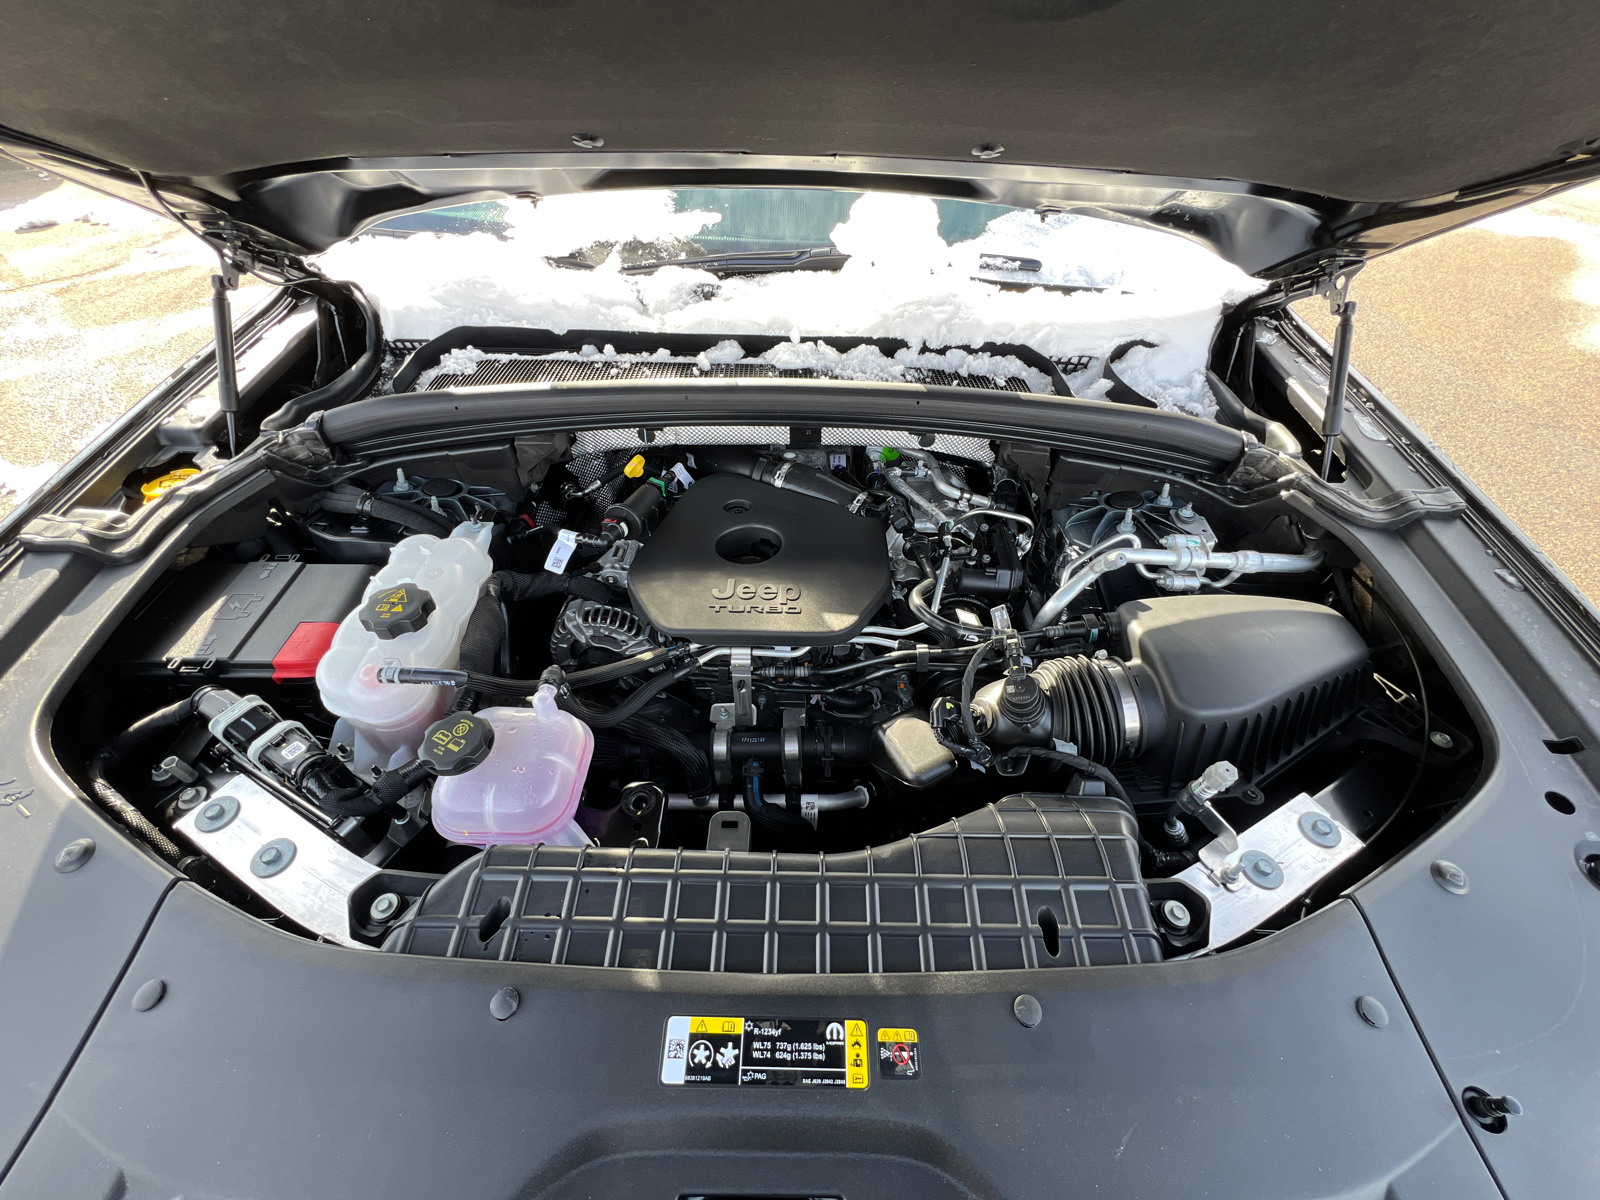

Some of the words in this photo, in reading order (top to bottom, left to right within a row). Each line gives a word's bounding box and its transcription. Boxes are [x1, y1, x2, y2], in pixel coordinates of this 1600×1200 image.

[711, 578, 802, 606] Jeep
[708, 604, 802, 614] TURBO
[753, 1027, 782, 1037] R-1234yf
[752, 1041, 772, 1049] WL75
[775, 1042, 792, 1051] 737g
[792, 1042, 812, 1051] (1.625
[812, 1043, 826, 1051] lbs)
[752, 1050, 771, 1058] WL74
[775, 1052, 791, 1060] 624g
[792, 1052, 812, 1061] (1.375
[812, 1052, 826, 1061] lbs)
[754, 1072, 767, 1080] PAG
